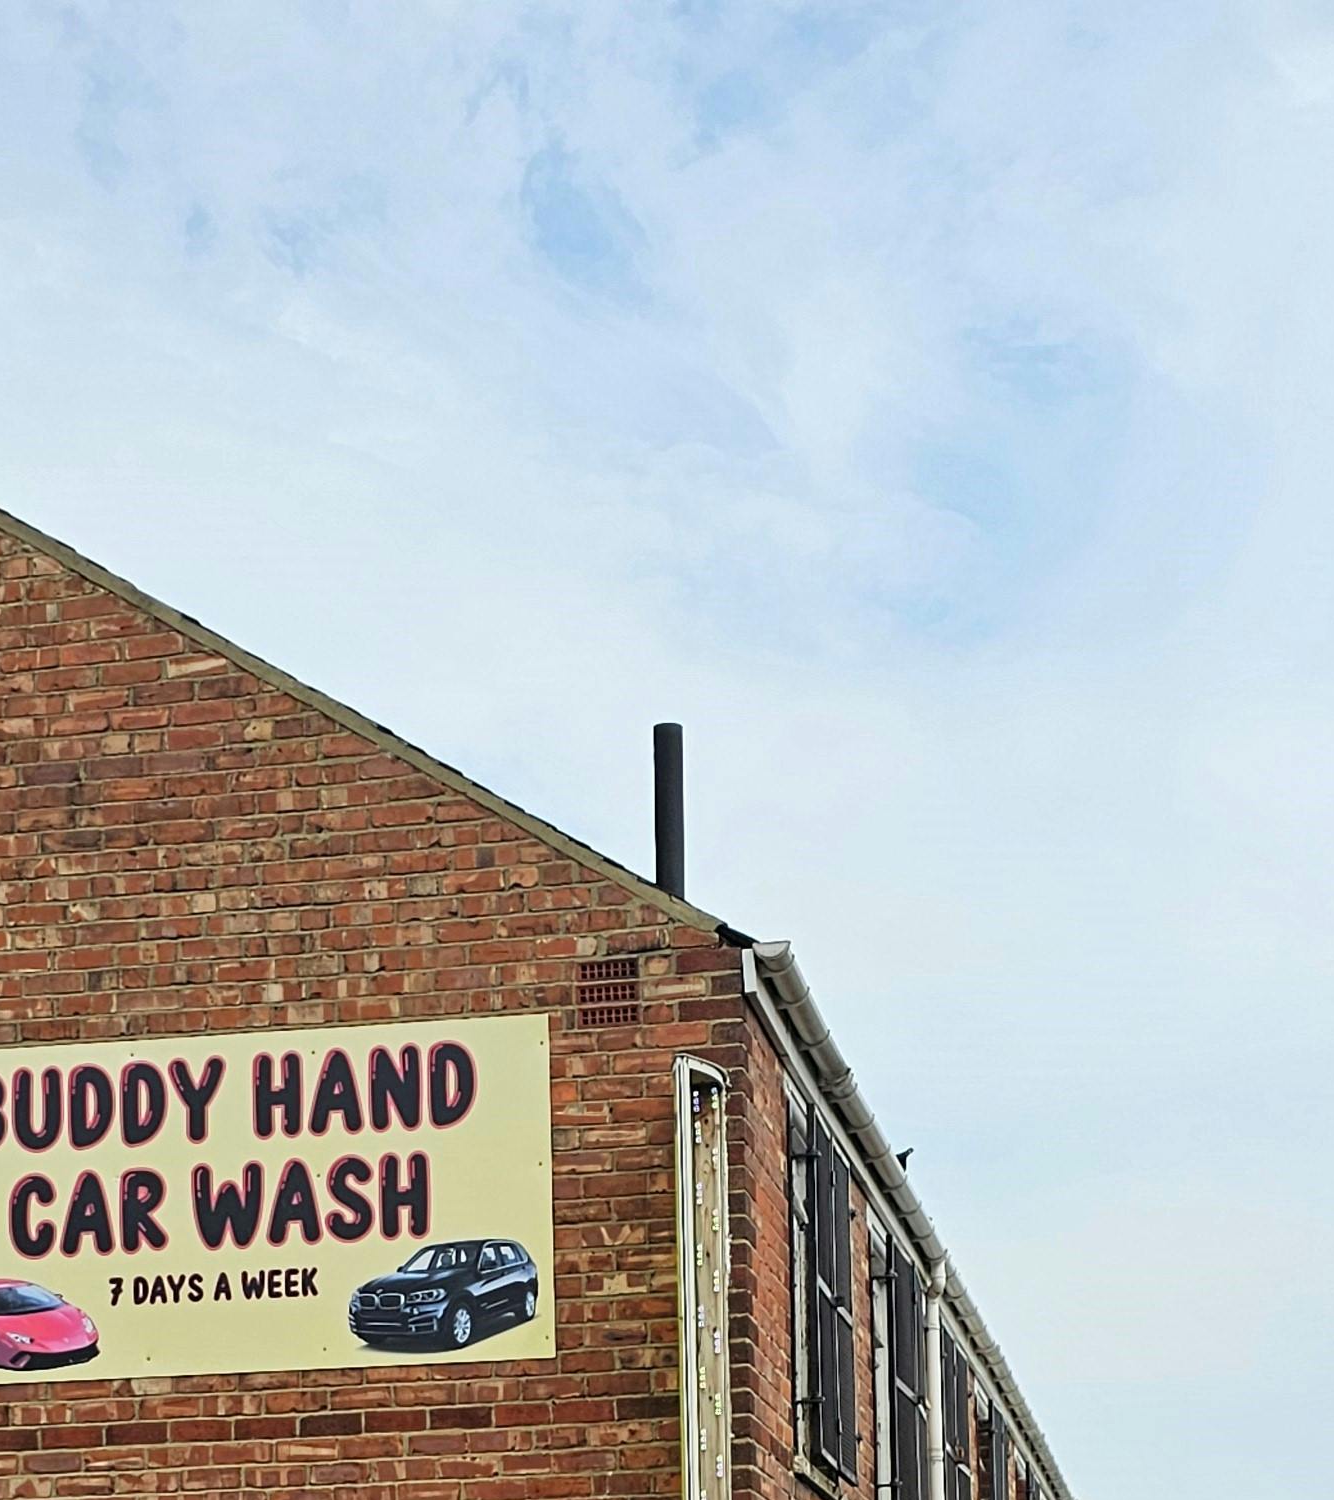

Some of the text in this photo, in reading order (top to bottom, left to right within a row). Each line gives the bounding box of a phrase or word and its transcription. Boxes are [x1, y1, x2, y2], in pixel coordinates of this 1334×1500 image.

[251, 1039, 478, 1139] HAND
[7, 1149, 432, 1261] CAR WASH
[108, 1267, 318, 1306] 7 DAYS A WEEK
